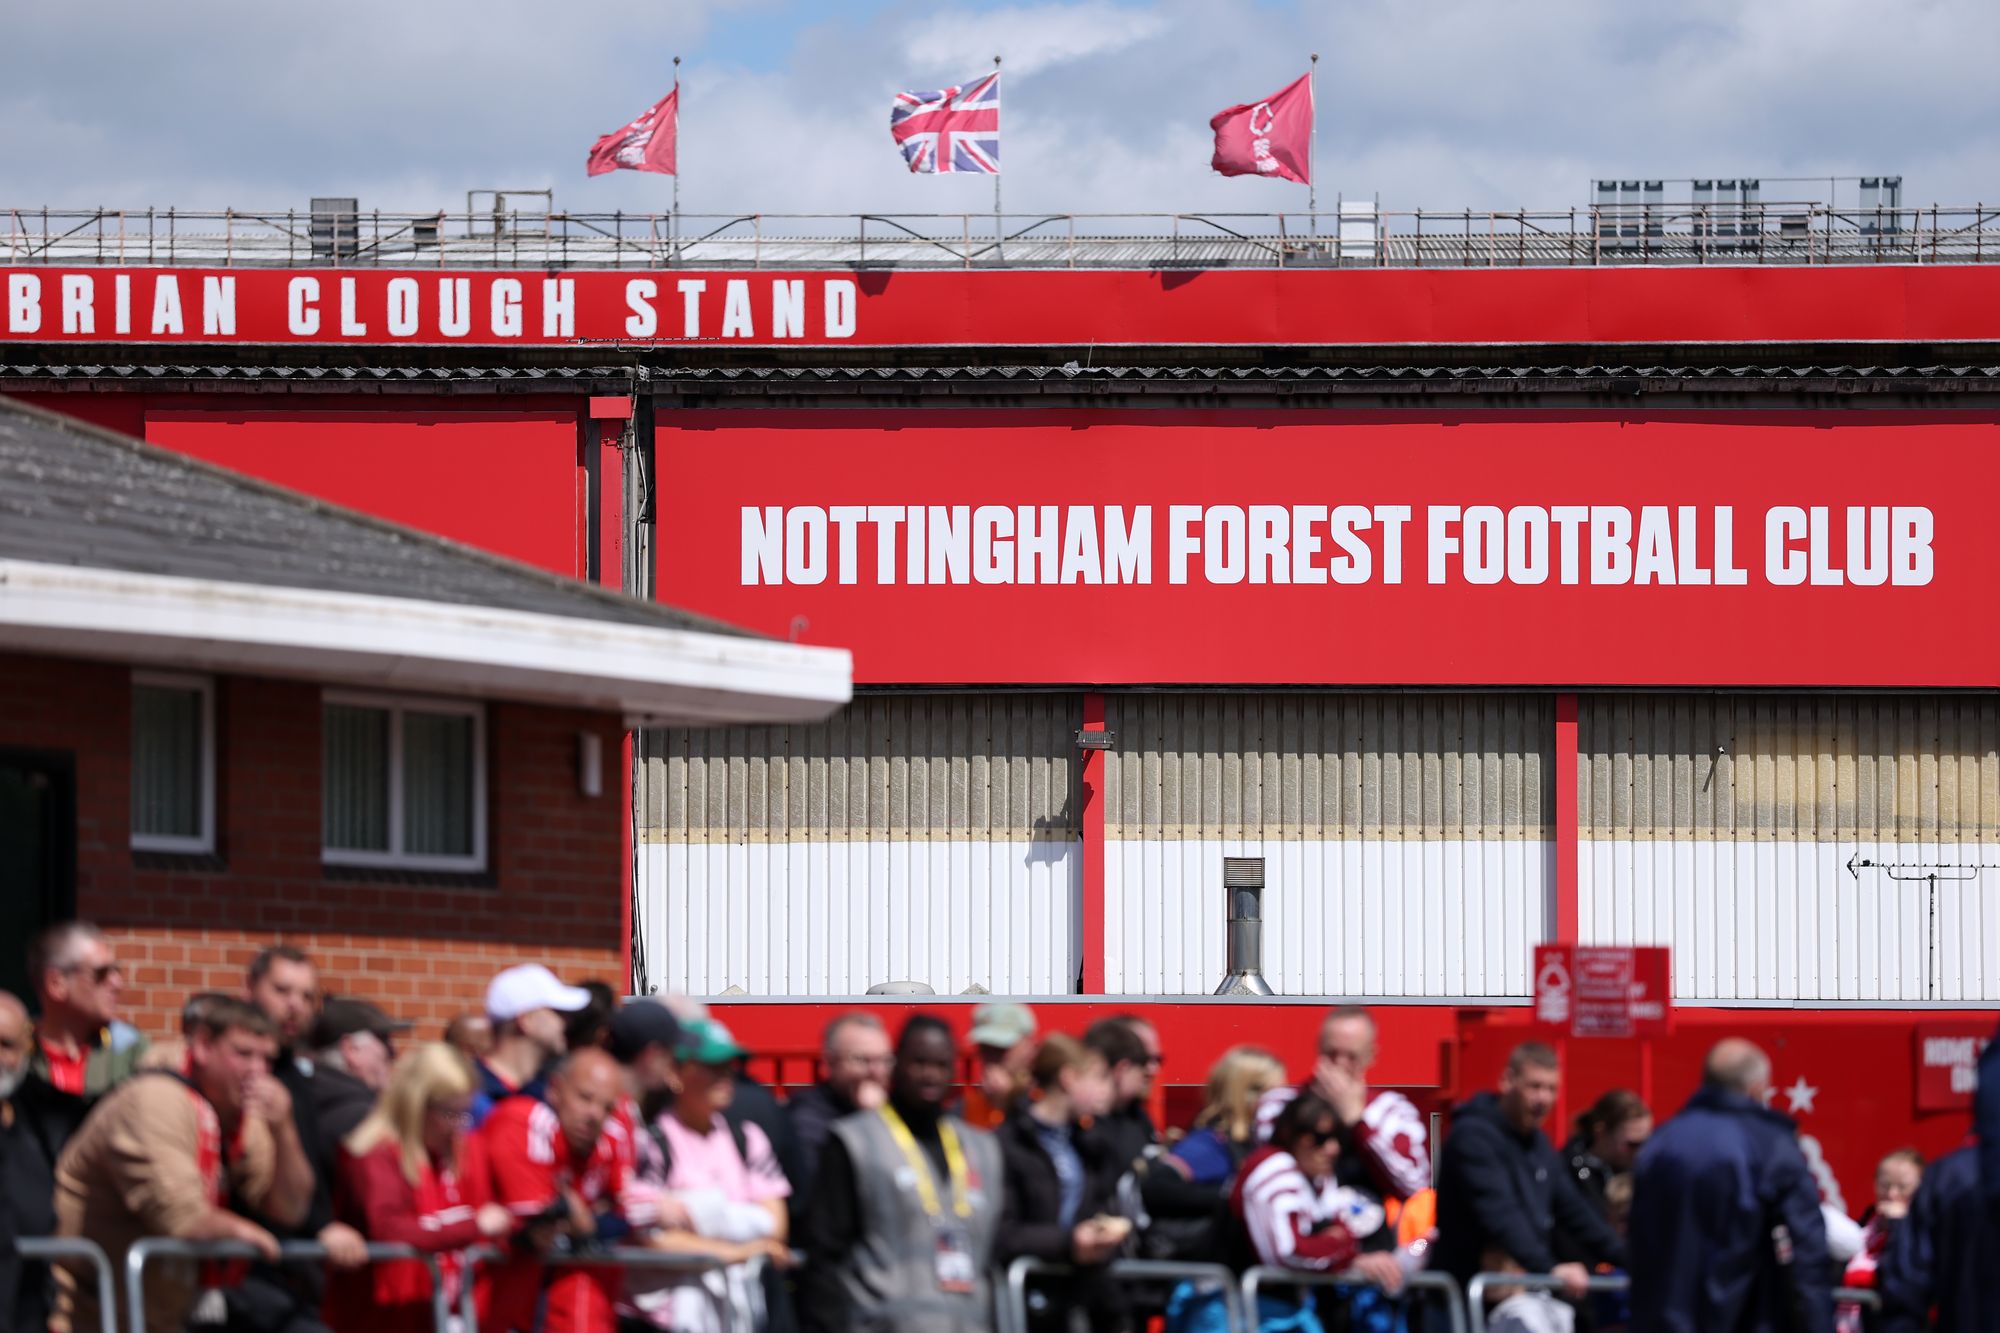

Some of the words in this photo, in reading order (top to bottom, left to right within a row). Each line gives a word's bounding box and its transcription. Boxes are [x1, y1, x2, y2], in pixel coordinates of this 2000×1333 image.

[8, 273, 236, 336] BRIAN
[287, 276, 575, 338] CLOUGH
[625, 278, 857, 339] STAND
[741, 505, 1153, 586] NOTTINGHAM
[1168, 504, 1412, 585] FOREST
[1427, 505, 1748, 586] FOOTBALL
[1765, 505, 1934, 587] CLUB
